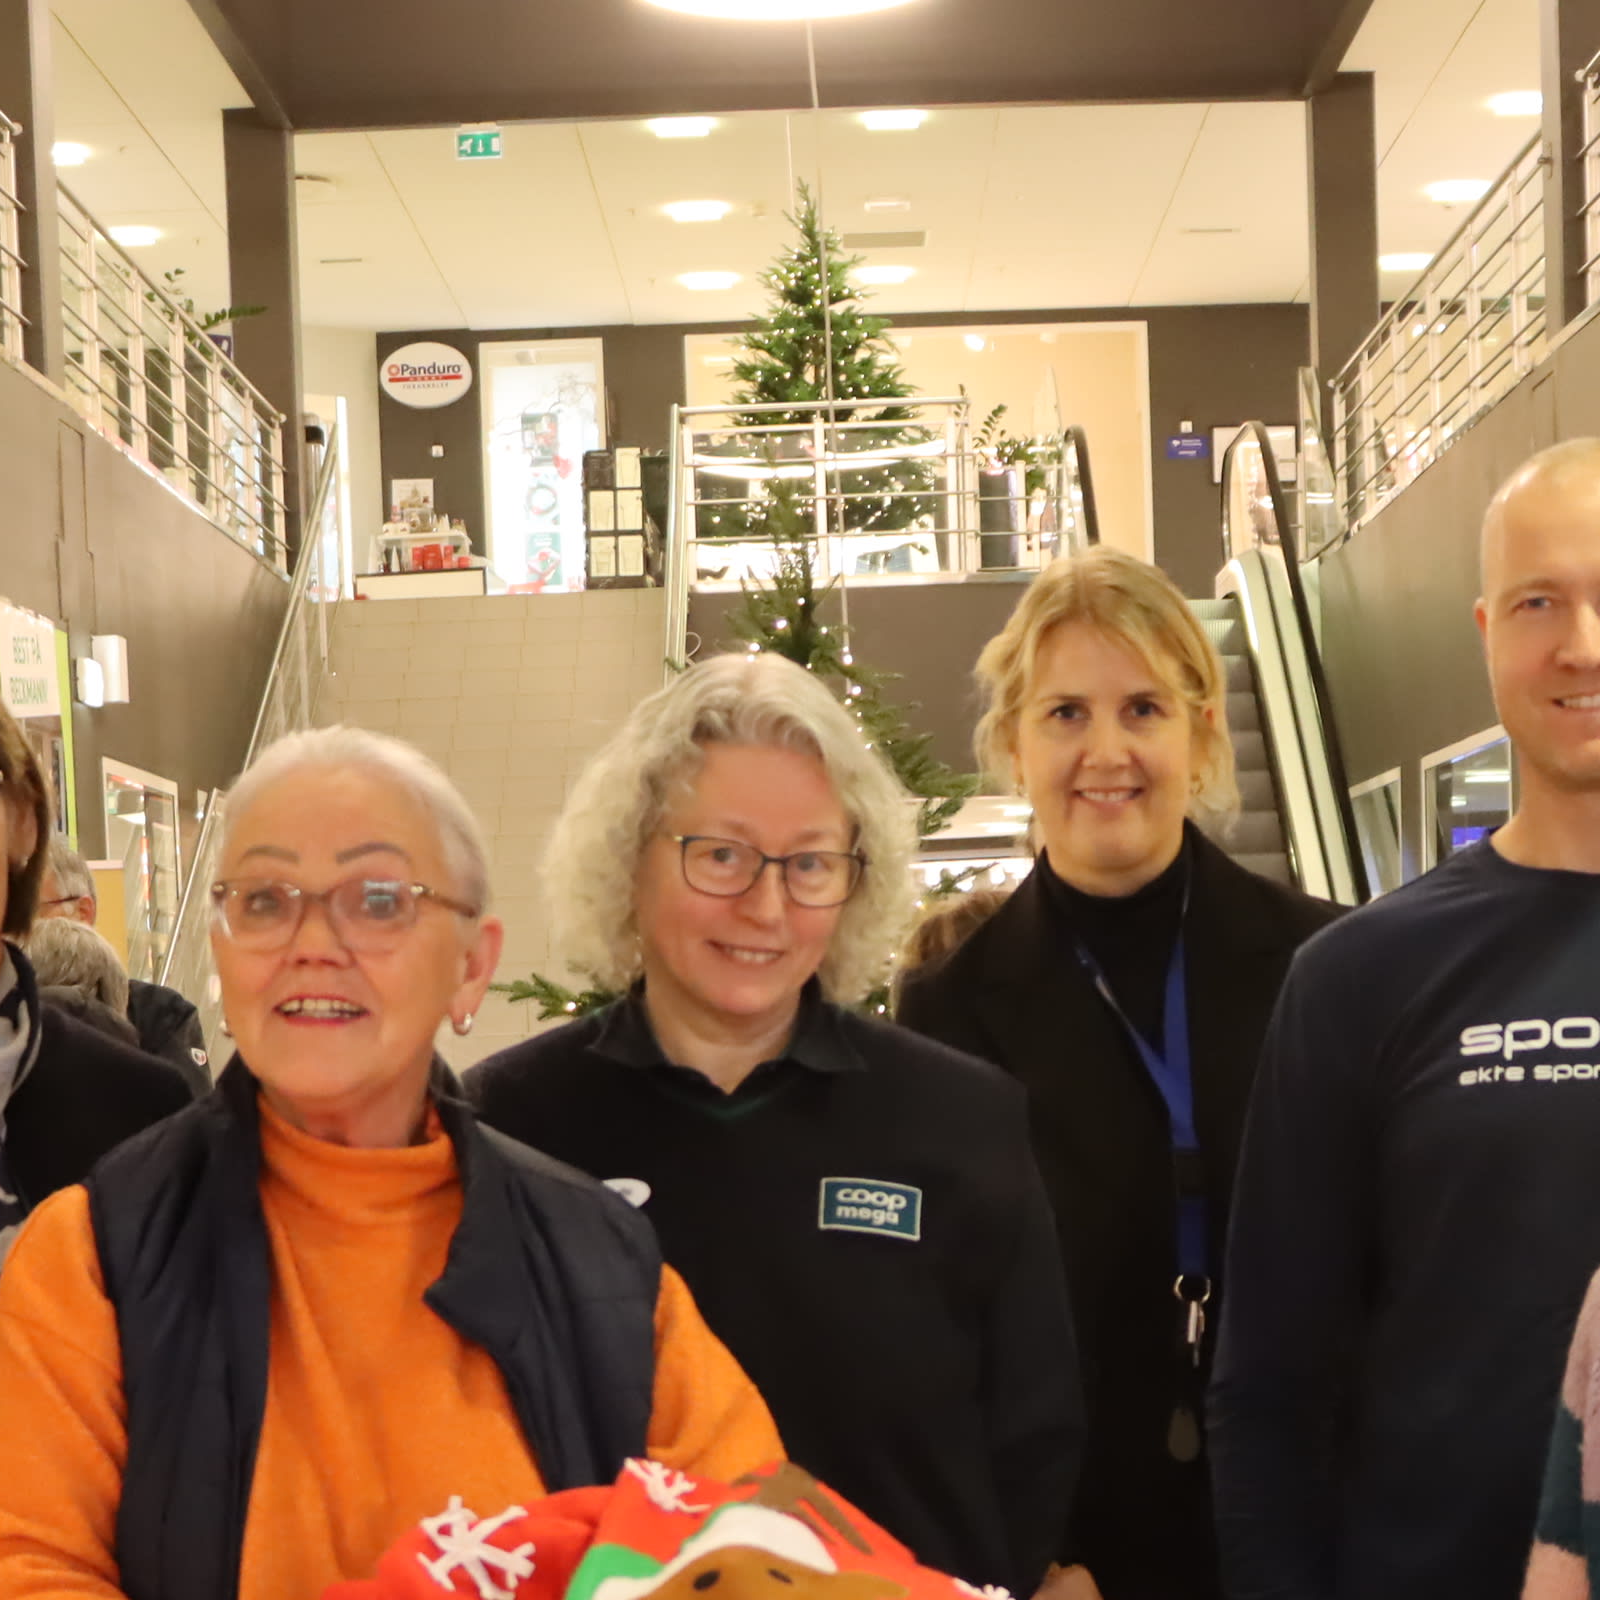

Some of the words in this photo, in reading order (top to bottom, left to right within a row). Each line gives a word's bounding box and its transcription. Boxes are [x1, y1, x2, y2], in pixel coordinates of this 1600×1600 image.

[401, 362, 461, 376] Panduro
[1459, 1065, 1525, 1086] ekte
[836, 1187, 907, 1211] coop
[837, 1204, 899, 1226] mega
